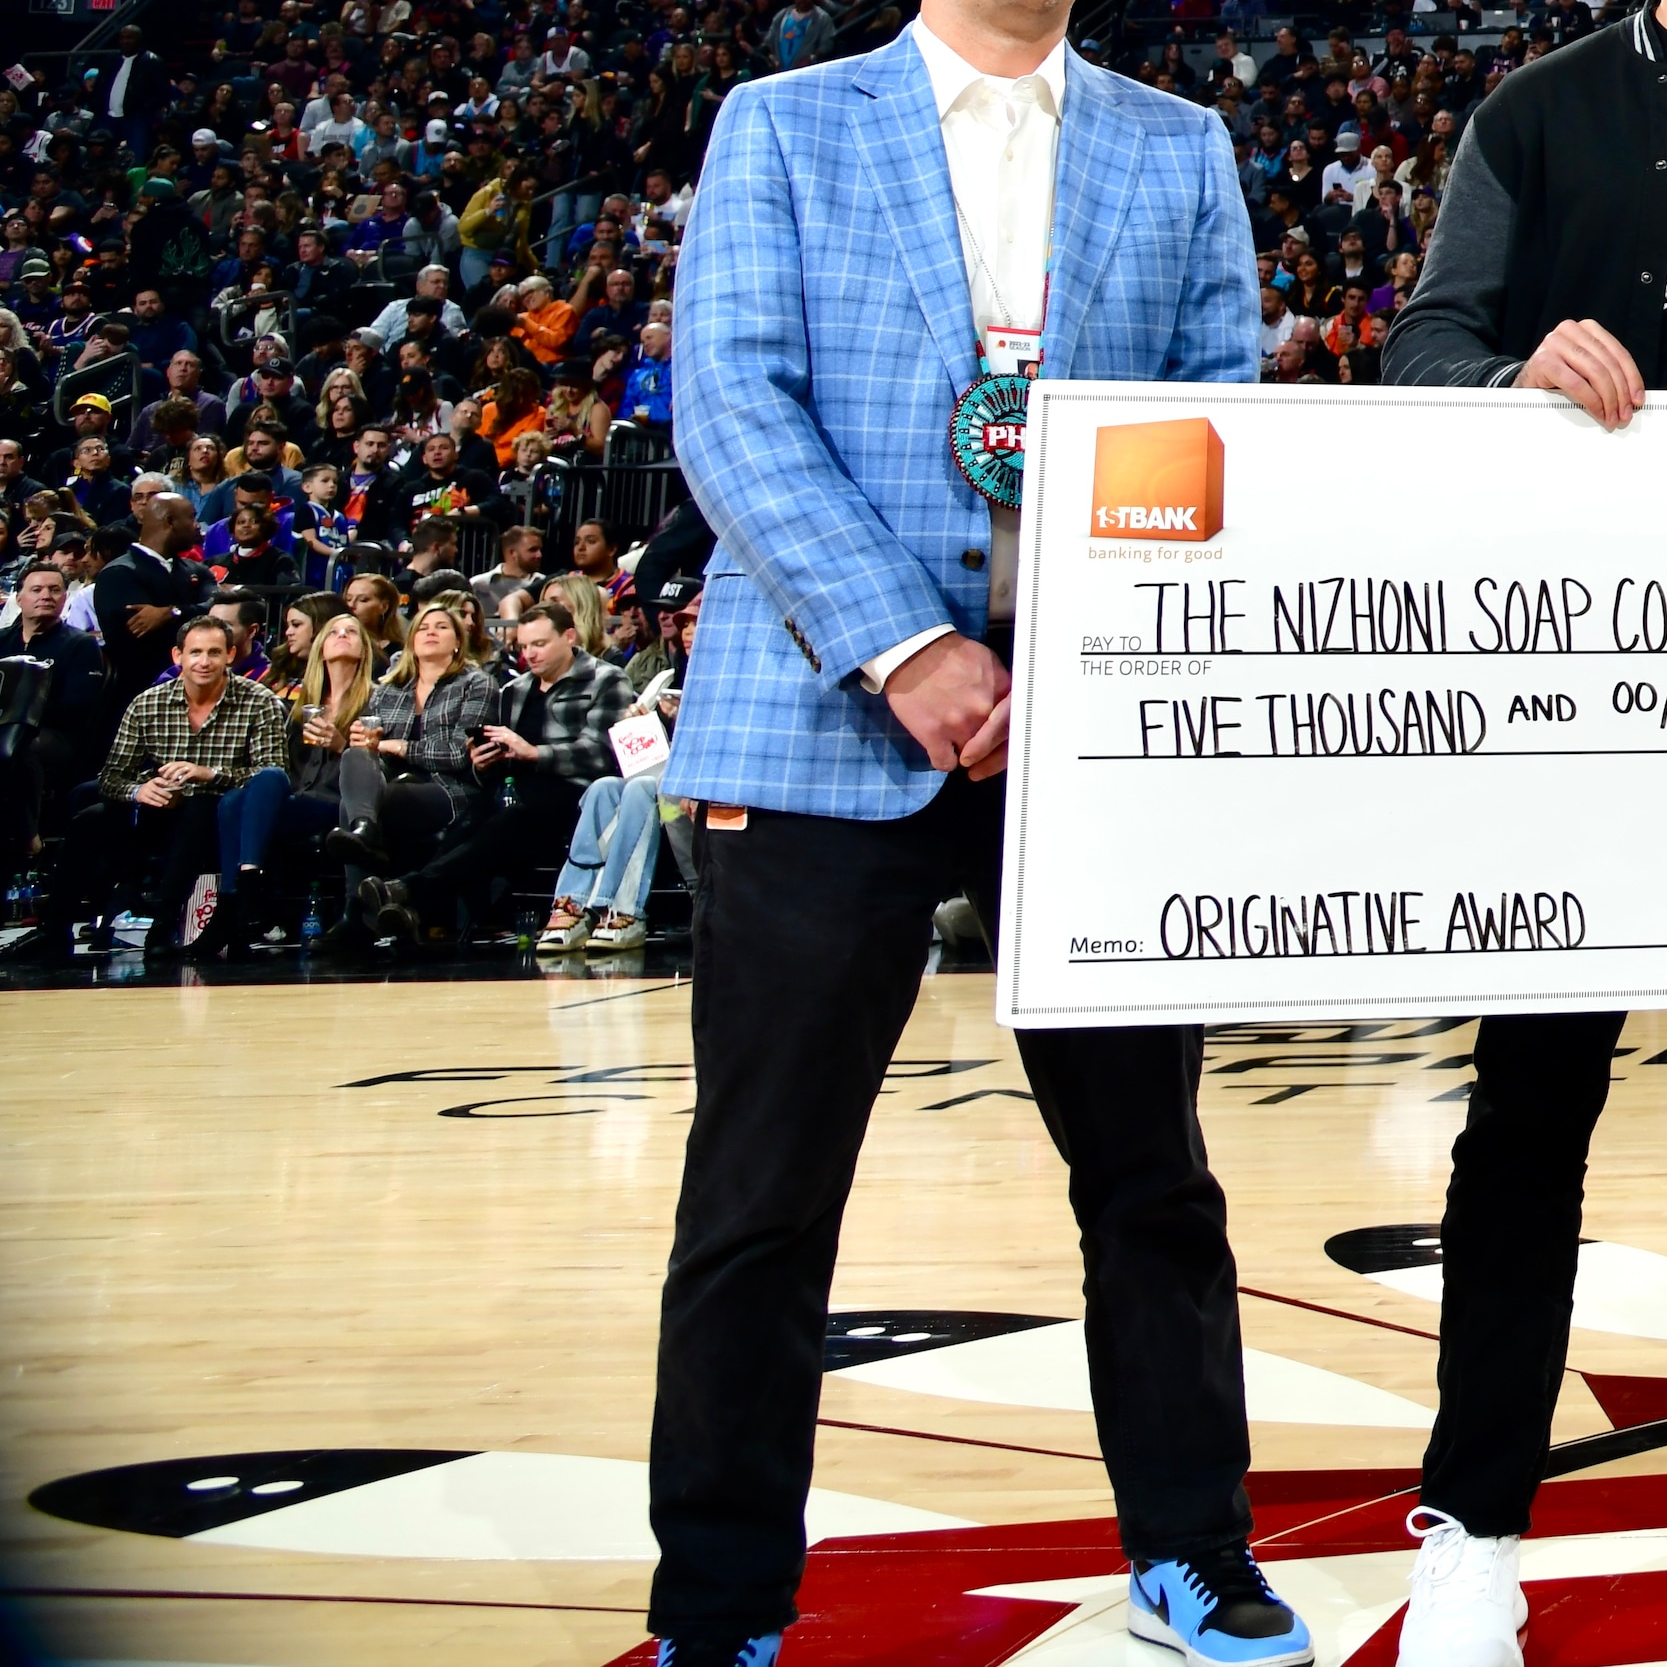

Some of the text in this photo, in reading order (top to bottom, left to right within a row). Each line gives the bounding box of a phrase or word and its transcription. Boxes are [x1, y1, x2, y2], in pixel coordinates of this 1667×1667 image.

[988, 425, 1027, 449] PH
[1088, 544, 1224, 564] banking for good
[1081, 635, 1112, 652] PAY
[1118, 635, 1142, 652] TO
[1133, 578, 1246, 655] THE
[1273, 576, 1449, 655] NIZHONI
[1468, 575, 1592, 654] SOAP
[1080, 659, 1212, 676] THE ORDER OF
[1139, 695, 1244, 759] FIVE
[1255, 688, 1487, 757] THOUSAND
[1507, 693, 1578, 724] AND
[1070, 890, 1587, 960] Memo: ORIGINATIVE AWARD
